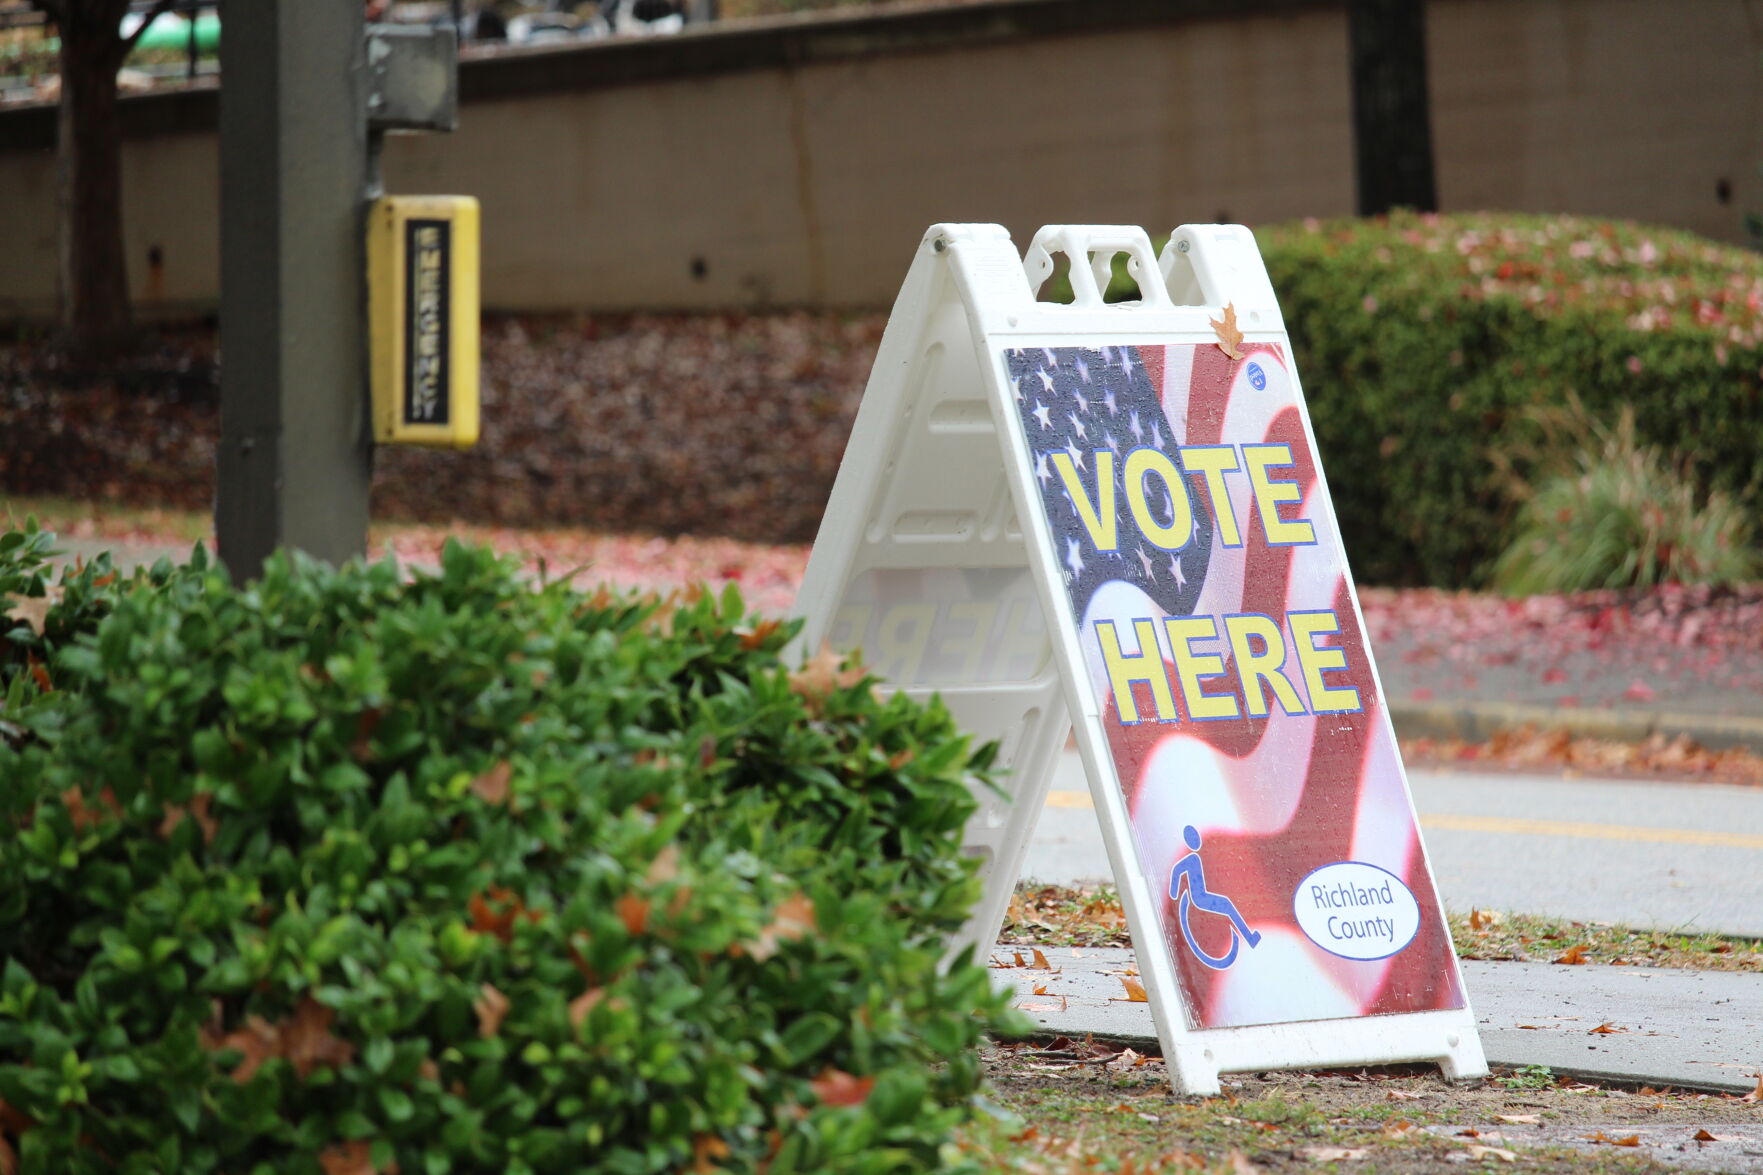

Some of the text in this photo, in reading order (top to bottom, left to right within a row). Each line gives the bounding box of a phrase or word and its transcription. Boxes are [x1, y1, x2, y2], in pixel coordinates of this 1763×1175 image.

[1047, 443, 1317, 553] VOTE
[1094, 609, 1363, 725] HERE
[1311, 880, 1393, 909] Richland
[1327, 916, 1394, 943] County
